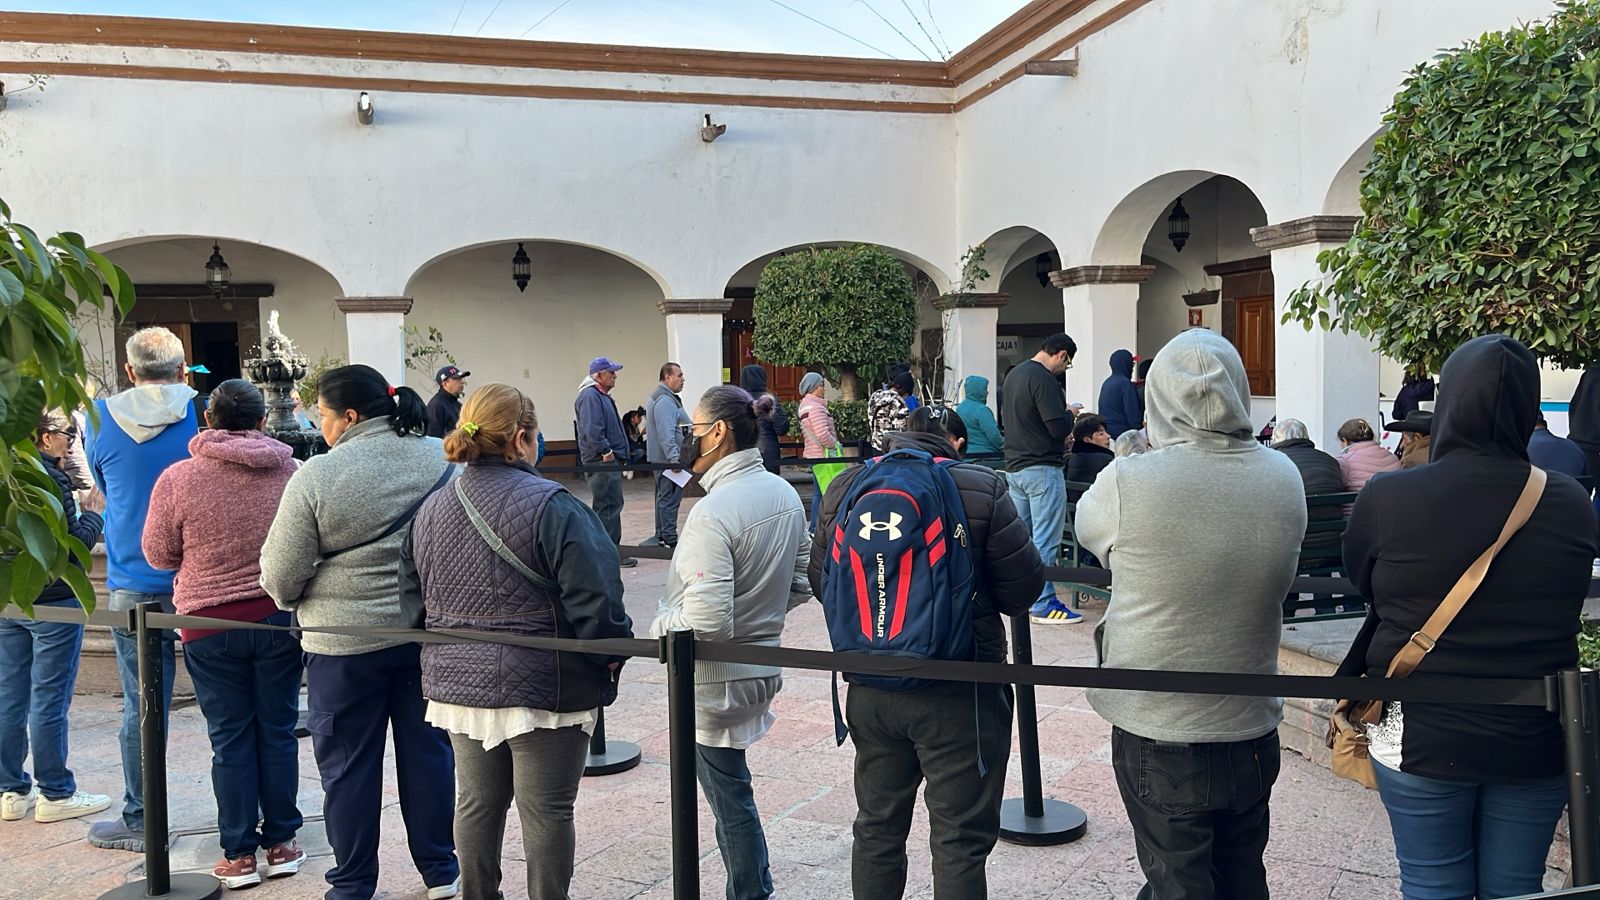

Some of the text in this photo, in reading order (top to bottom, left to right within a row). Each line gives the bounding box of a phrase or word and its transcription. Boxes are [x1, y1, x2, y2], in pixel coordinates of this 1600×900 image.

[996, 341, 1013, 351] CAJA
[876, 553, 887, 638] UNDER ARMOUR
